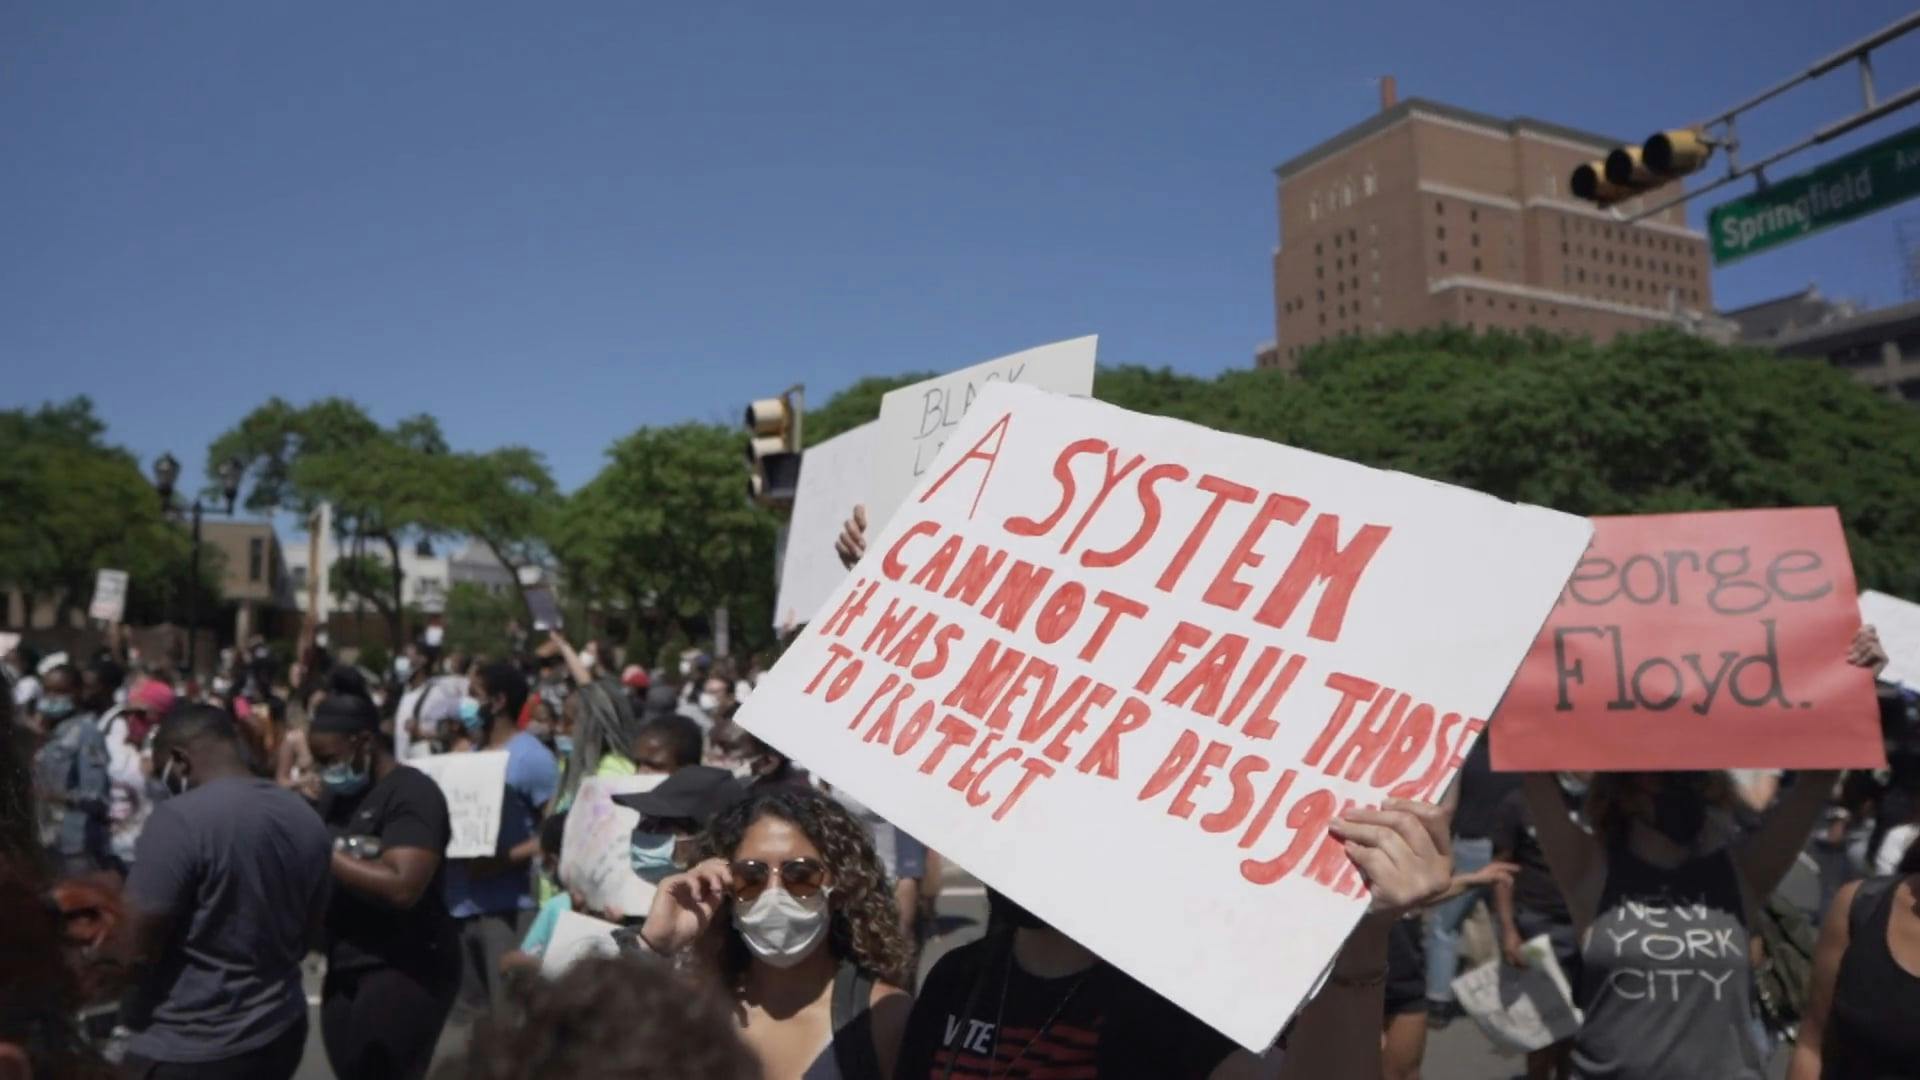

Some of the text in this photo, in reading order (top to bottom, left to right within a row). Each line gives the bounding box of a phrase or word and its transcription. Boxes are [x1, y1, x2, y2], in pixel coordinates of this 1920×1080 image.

[1721, 165, 1872, 248] Springfield
[919, 411, 1392, 642] A SYSTEM
[1559, 541, 1833, 616] eorge
[861, 597, 965, 680] WAS
[942, 638, 1152, 780] NEVER
[882, 521, 1489, 805] CANNOT FAIL THOSE
[1553, 619, 1814, 716] Floyd.
[803, 642, 1056, 821] TO PROTECT
[1606, 928, 1743, 961] YORK
[1617, 895, 1708, 928] NEW
[1609, 967, 1735, 1003] CITY
[942, 1013, 996, 1054] VTE
